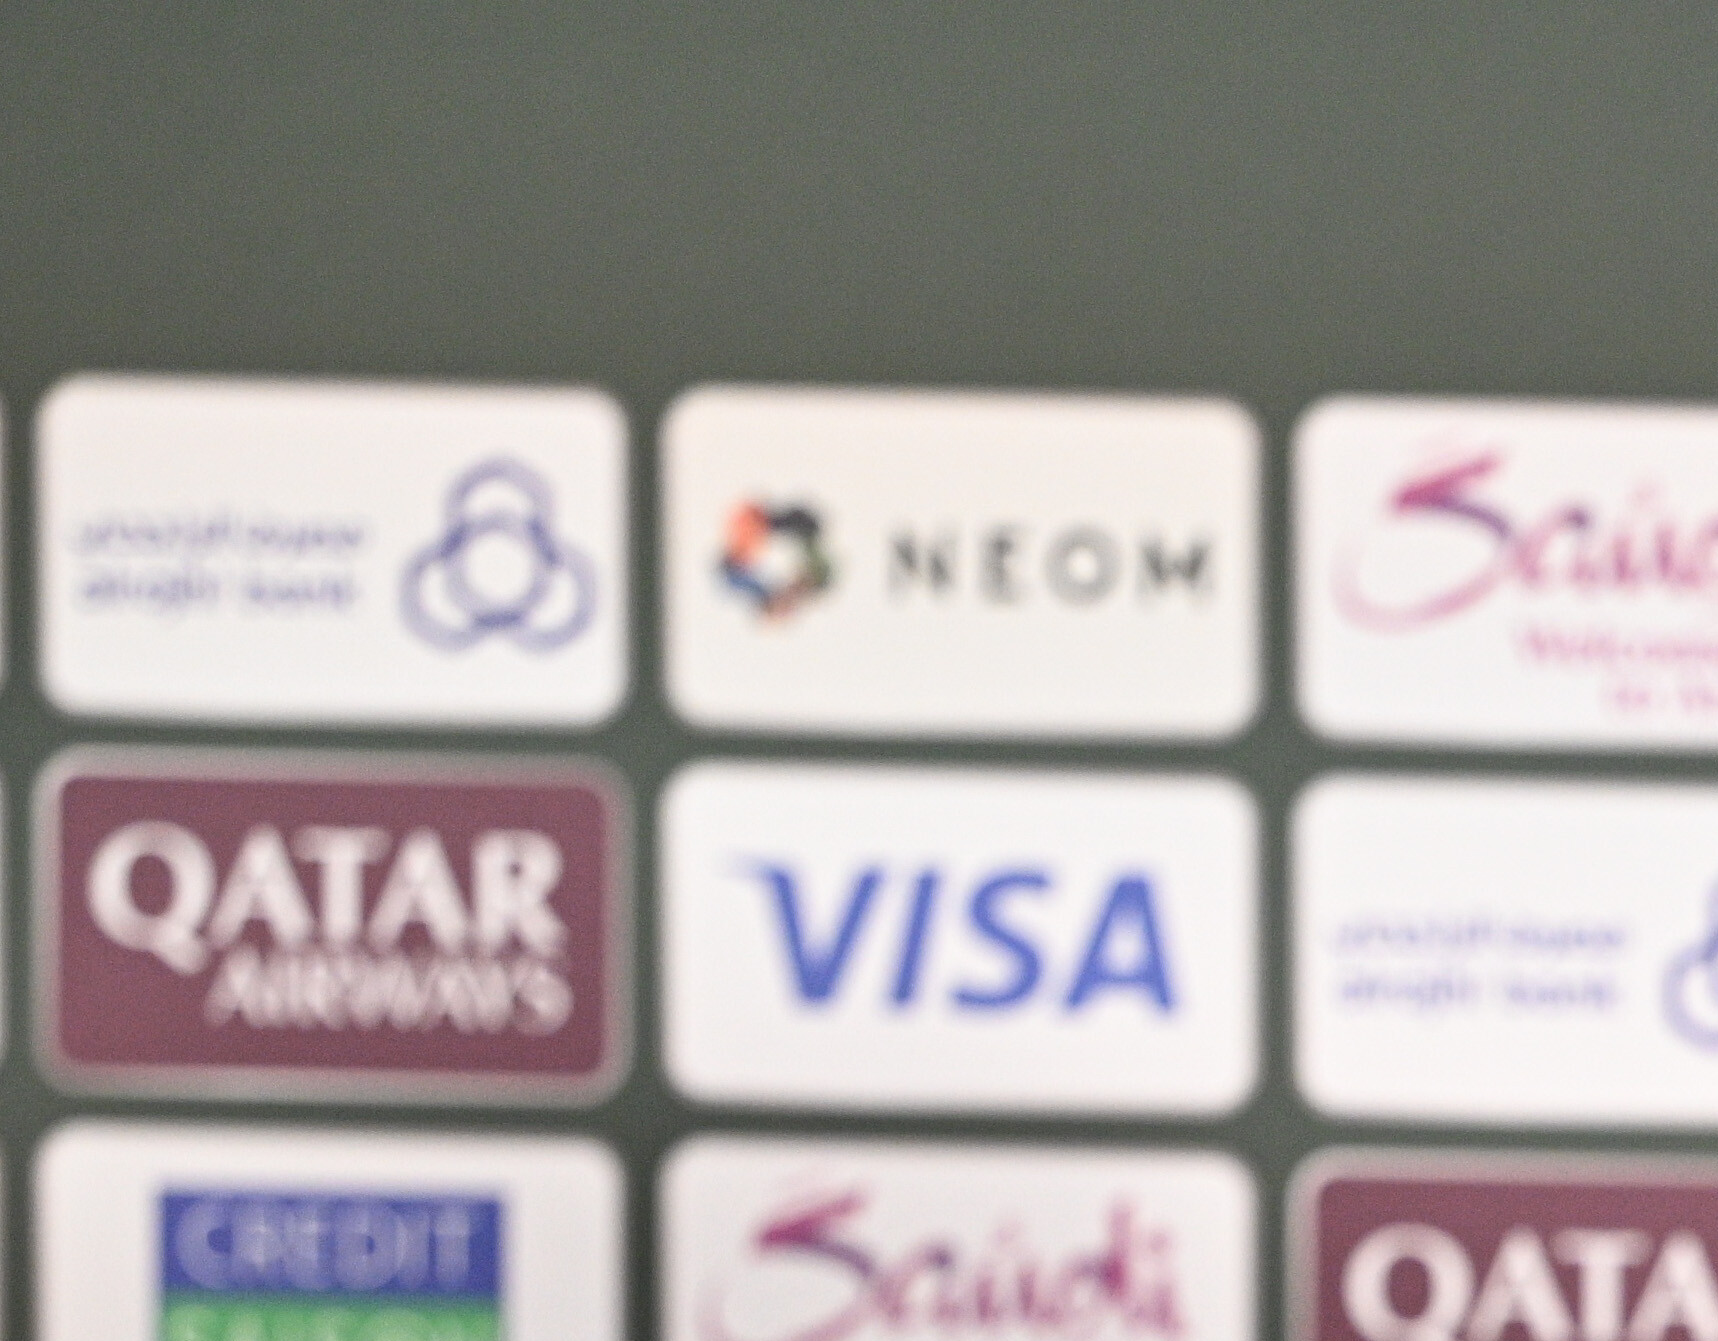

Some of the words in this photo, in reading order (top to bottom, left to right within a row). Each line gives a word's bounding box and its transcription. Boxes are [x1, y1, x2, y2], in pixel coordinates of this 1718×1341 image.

[886, 524, 1216, 606] NEOM
[88, 820, 567, 976] QATAR
[742, 862, 1180, 1017] VISA
[205, 955, 573, 1034] AIRWAYS
[174, 1200, 475, 1290] CREDIT
